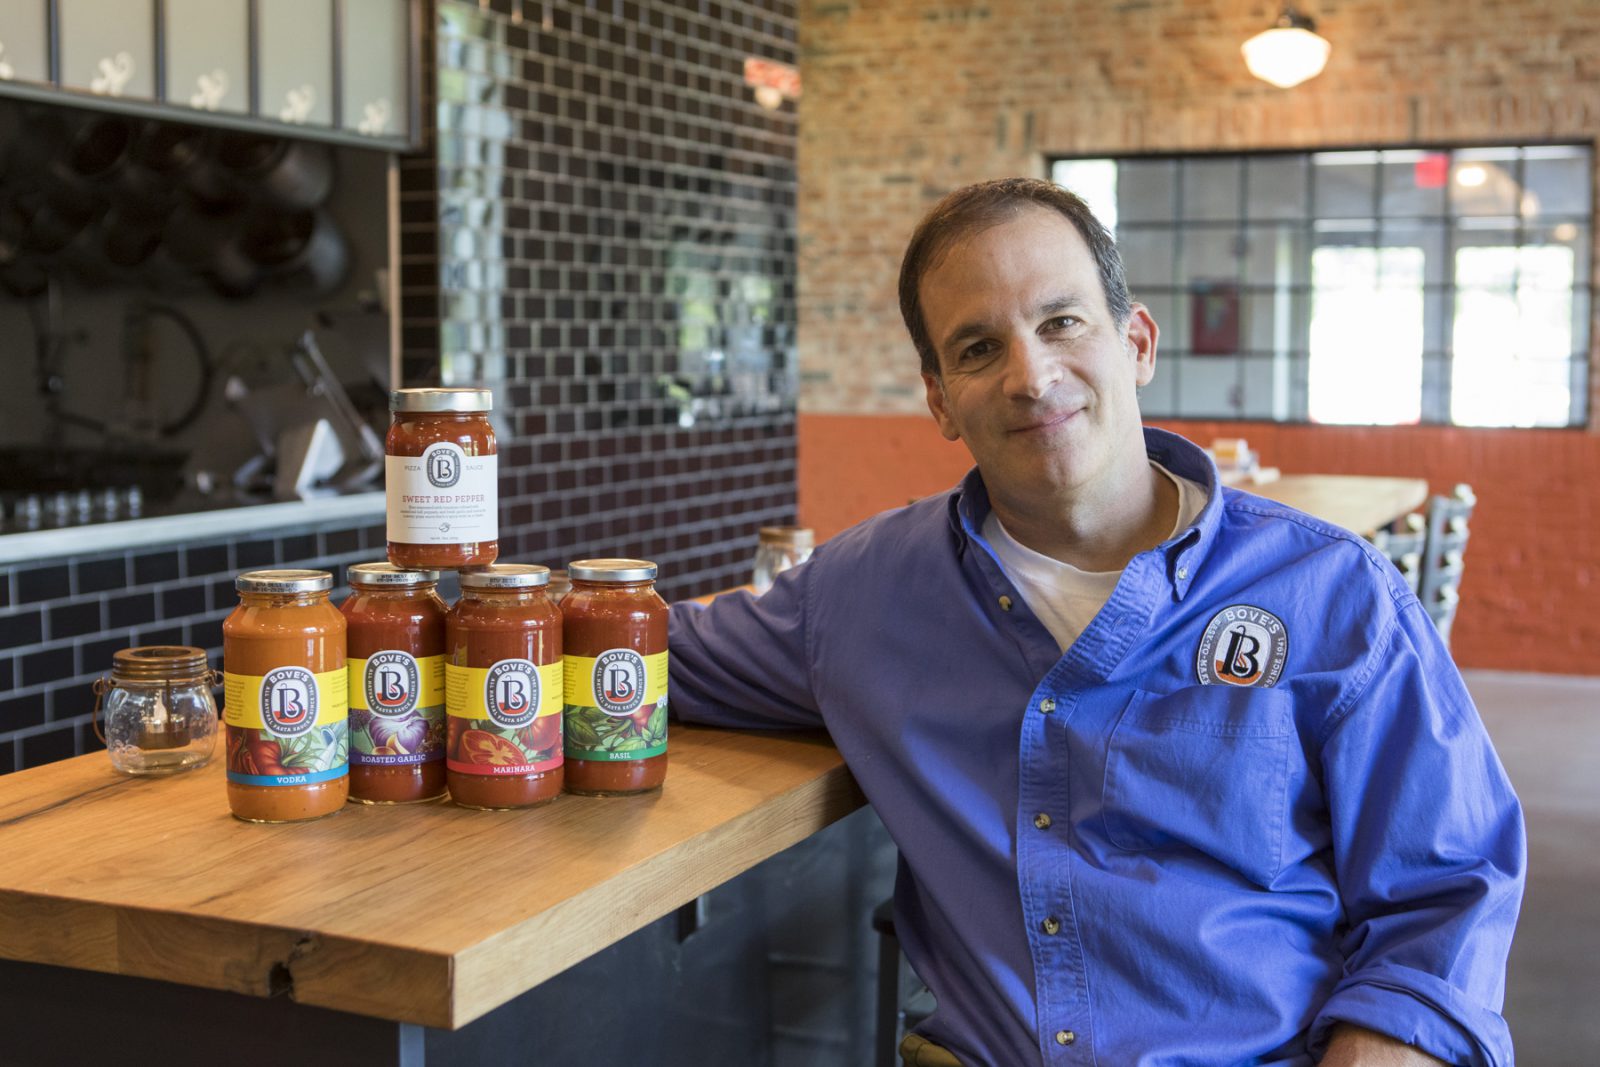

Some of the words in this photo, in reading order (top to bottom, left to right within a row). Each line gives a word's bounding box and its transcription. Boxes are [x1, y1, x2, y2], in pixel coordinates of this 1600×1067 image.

[402, 495, 431, 503] SWEET
[455, 494, 484, 502] PEPPER
[1225, 609, 1280, 634] BOVE'S
[602, 653, 638, 665] BOVE'S
[1218, 630, 1260, 678] B
[372, 654, 411, 667] BOVE'S
[494, 664, 532, 676] BOVE'S
[1266, 658, 1282, 685] SINCE
[269, 670, 310, 684] BOVE'S
[379, 671, 404, 700] B
[609, 669, 632, 698] B
[502, 680, 526, 710] B
[276, 688, 304, 719] B
[394, 702, 411, 712] SAUCE
[622, 700, 639, 710] SAUCE
[516, 712, 532, 722] SAUCE
[272, 724, 292, 732] PASTA
[293, 720, 310, 732] SAUCE
[361, 756, 396, 764] ROASTED
[398, 754, 426, 763] GARLIC
[610, 752, 631, 760] BASIL
[494, 765, 535, 774] MARINARA
[277, 776, 307, 784] VODKA
